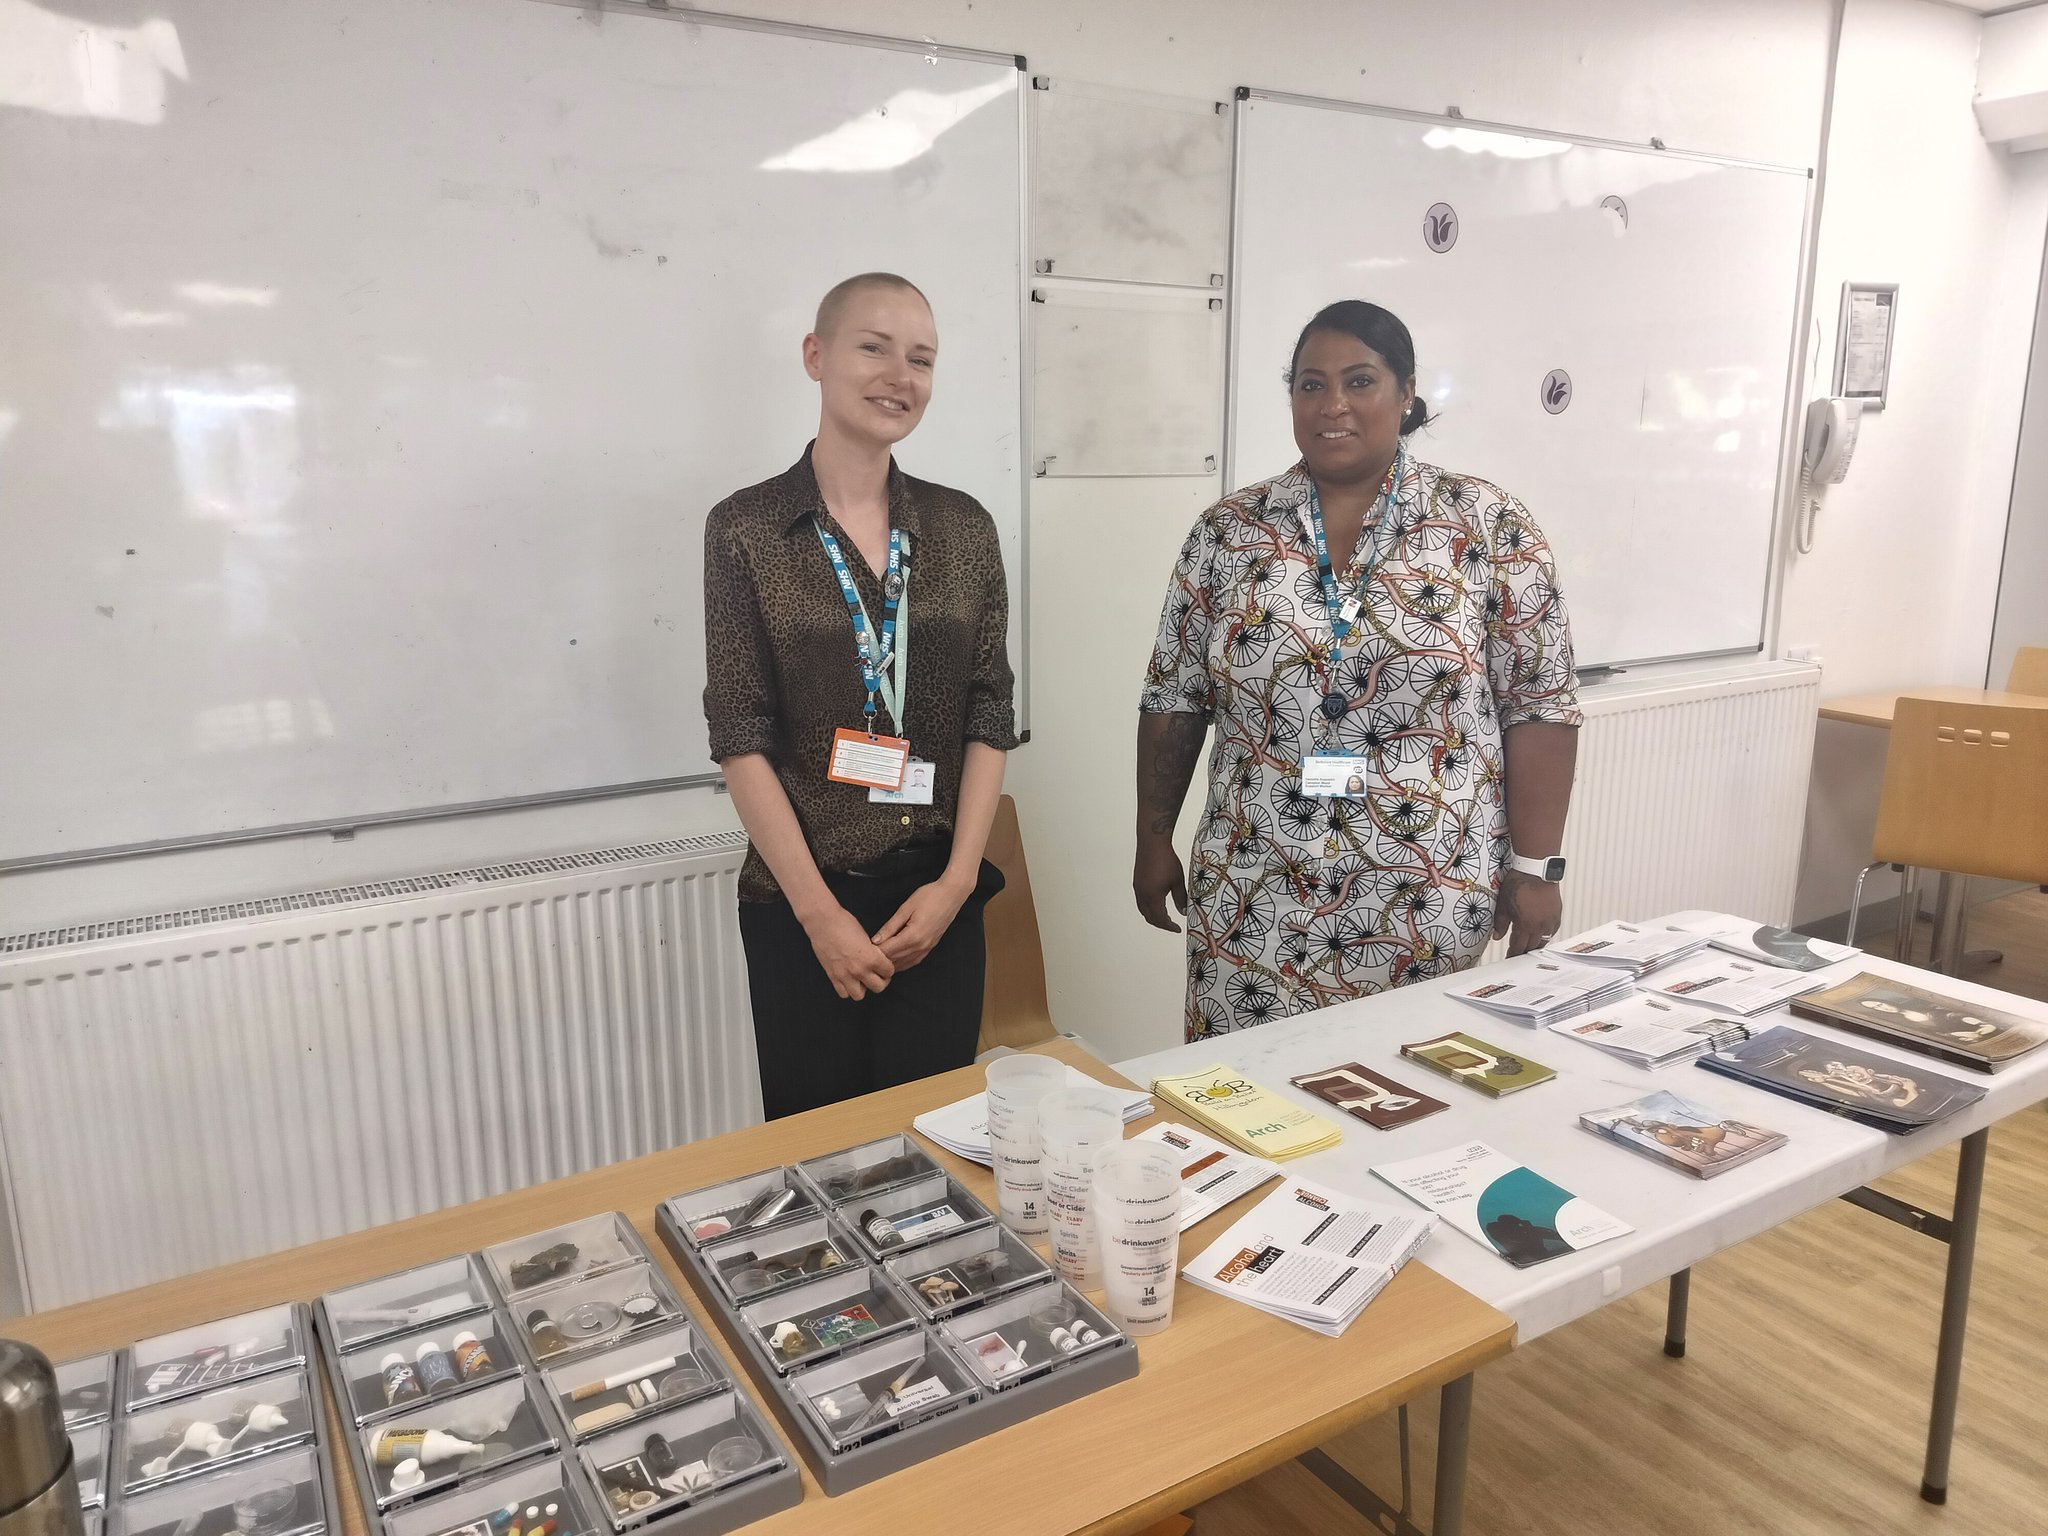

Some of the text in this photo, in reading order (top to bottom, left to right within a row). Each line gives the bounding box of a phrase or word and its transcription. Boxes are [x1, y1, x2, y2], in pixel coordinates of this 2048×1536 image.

[1312, 498, 1320, 514] NHS
[1314, 518, 1324, 534] NHS
[828, 544, 842, 564] NHS
[1318, 539, 1327, 555] NHS
[890, 549, 899, 570] NHS
[838, 570, 852, 590] NHS
[1325, 584, 1336, 600] NHS
[1330, 607, 1340, 624] NHS
[882, 632, 892, 654] NHS
[1246, 1123, 1287, 1138] Arch
[1004, 1156, 1040, 1164] drinkawar
[1298, 1196, 1327, 1211] ALCOHOL
[1060, 1230, 1079, 1239] Spirits
[1569, 1222, 1594, 1238] Arch
[1058, 1247, 1076, 1257] Spirits
[1219, 1249, 1258, 1282] Alcohol
[1254, 1233, 1273, 1251] and
[1236, 1248, 1282, 1287] the heart
[1144, 1286, 1155, 1296] 14
[903, 1385, 934, 1400] Universal
[896, 1400, 921, 1412] Alcotip
